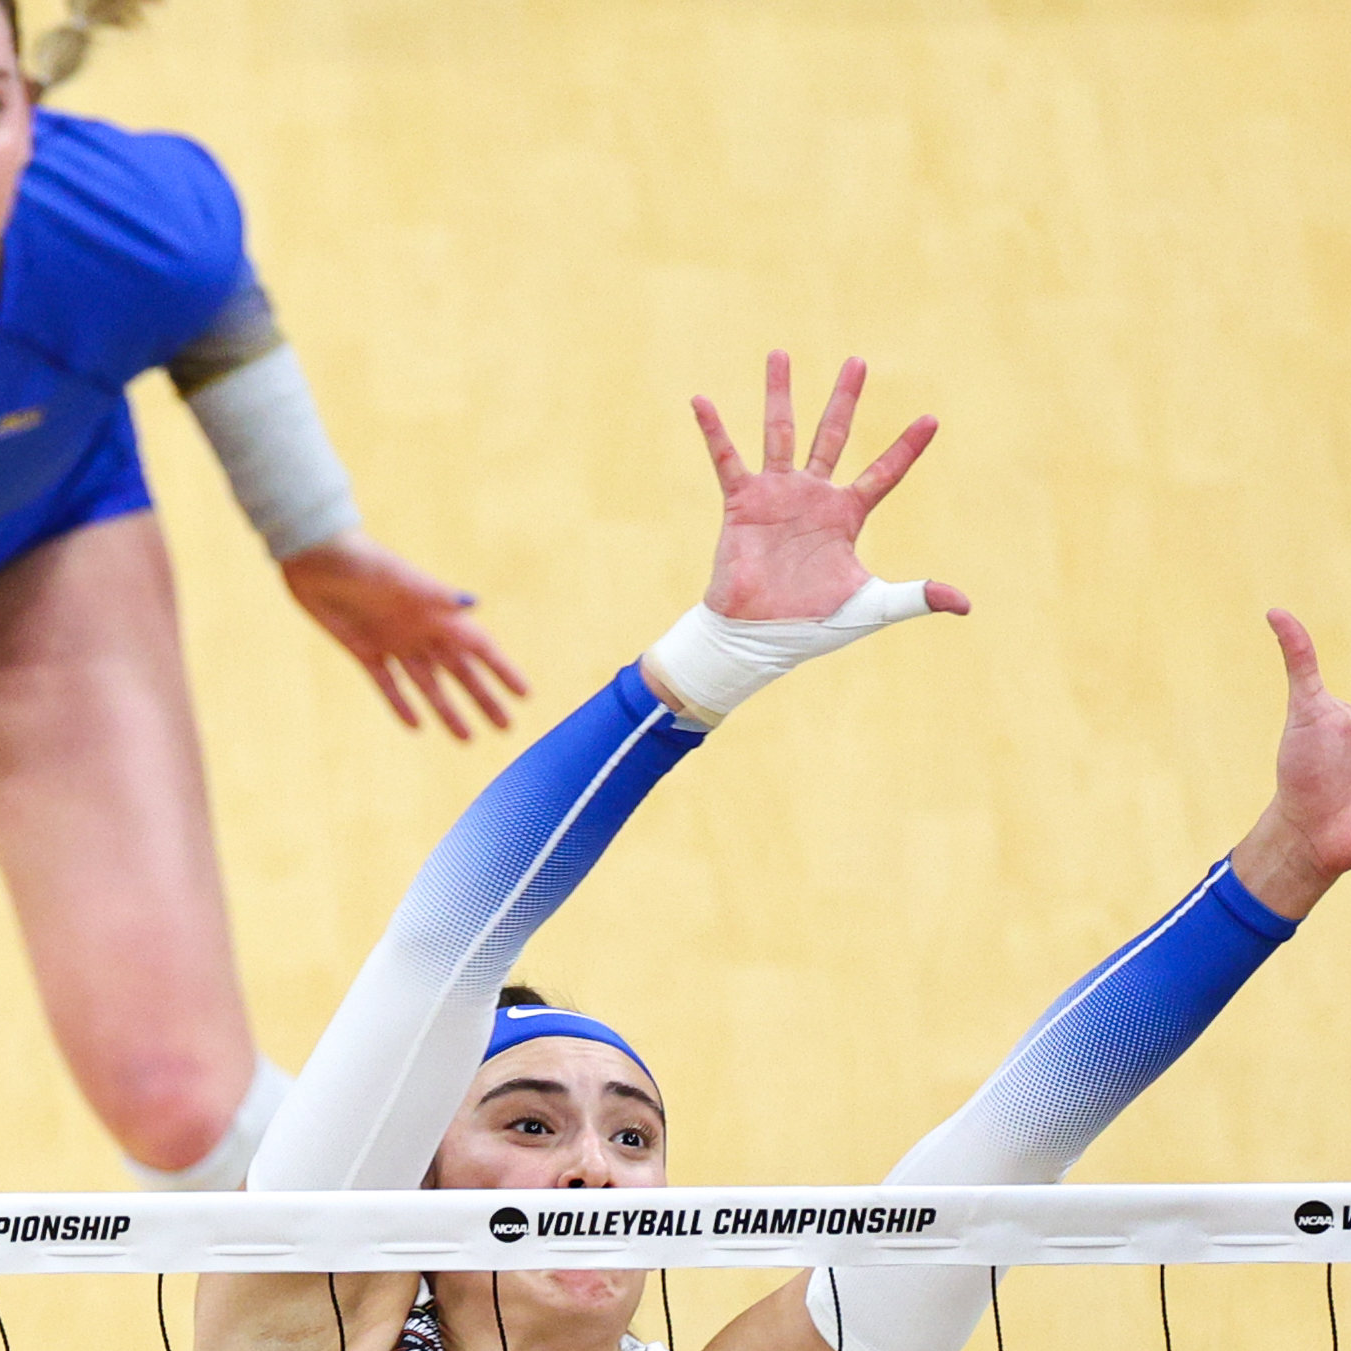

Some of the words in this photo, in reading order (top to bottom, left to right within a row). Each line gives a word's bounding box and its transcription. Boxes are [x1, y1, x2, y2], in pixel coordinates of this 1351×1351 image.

[493, 1223, 529, 1235] NCAA
[537, 1209, 703, 1237] VOLLEYBALL
[712, 1207, 937, 1235] CHAMPIONSHIP
[1298, 1216, 1334, 1227] NCAA
